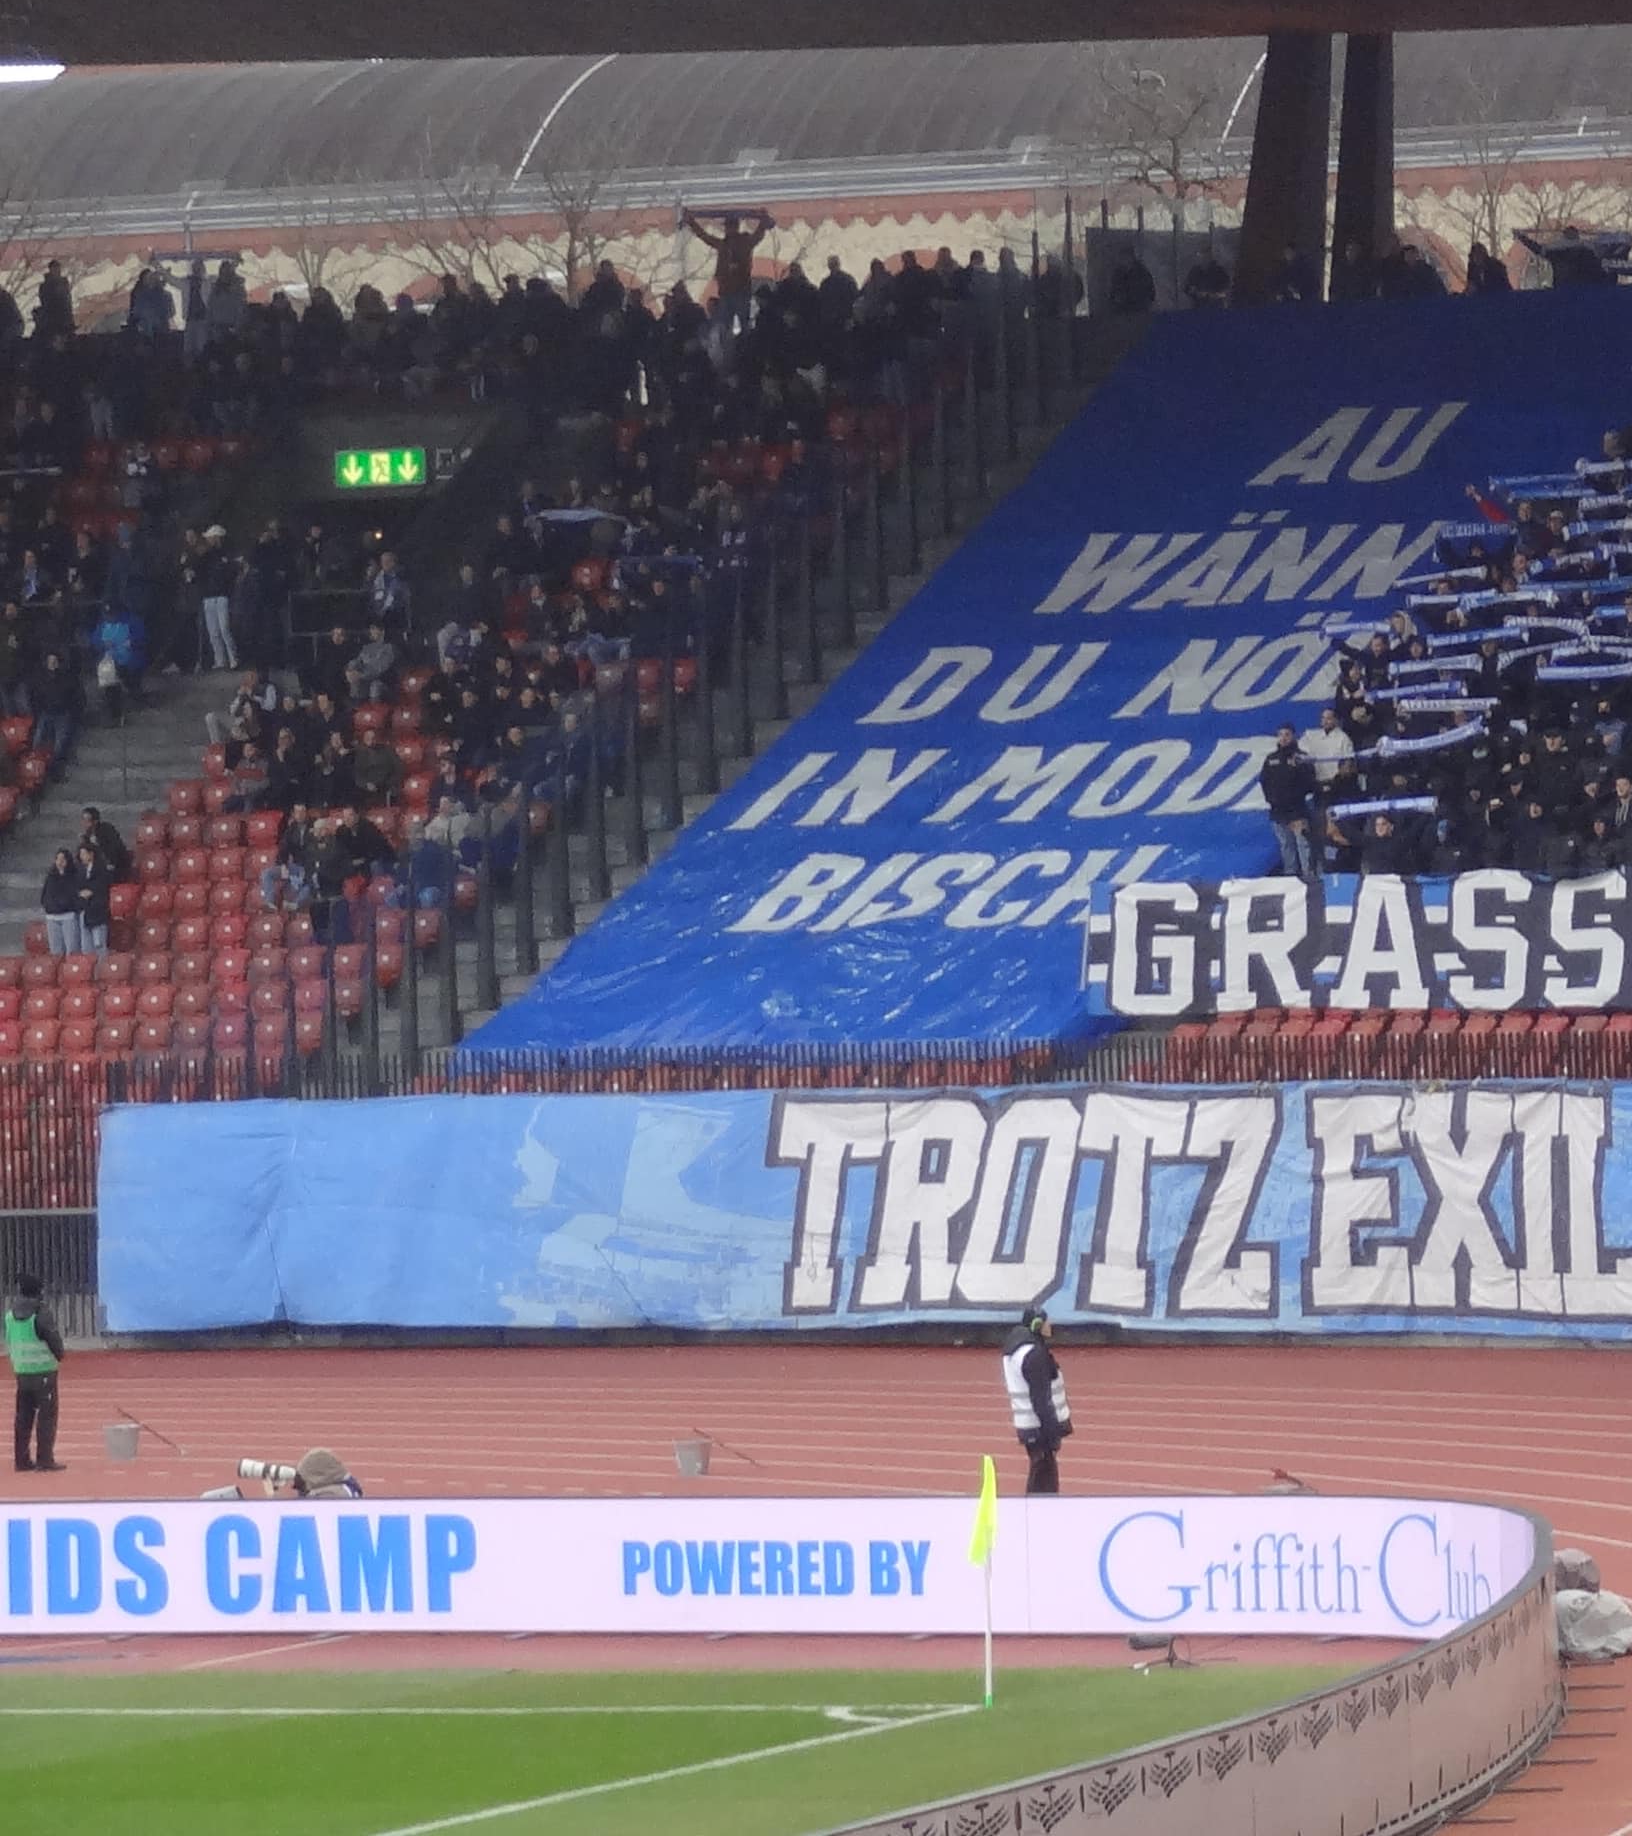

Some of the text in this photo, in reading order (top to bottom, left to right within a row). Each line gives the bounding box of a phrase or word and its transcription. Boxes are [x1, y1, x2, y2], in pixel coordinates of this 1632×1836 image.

[1248, 402, 1469, 486] AU
[1034, 510, 1444, 614] WÄNN
[857, 645, 1111, 725] DU
[727, 736, 1272, 832] IN MOD
[766, 1088, 1283, 1318] TROTZ
[205, 1513, 477, 1614] CAMP
[622, 1540, 854, 1597] POWERED
[869, 1540, 931, 1597] BY
